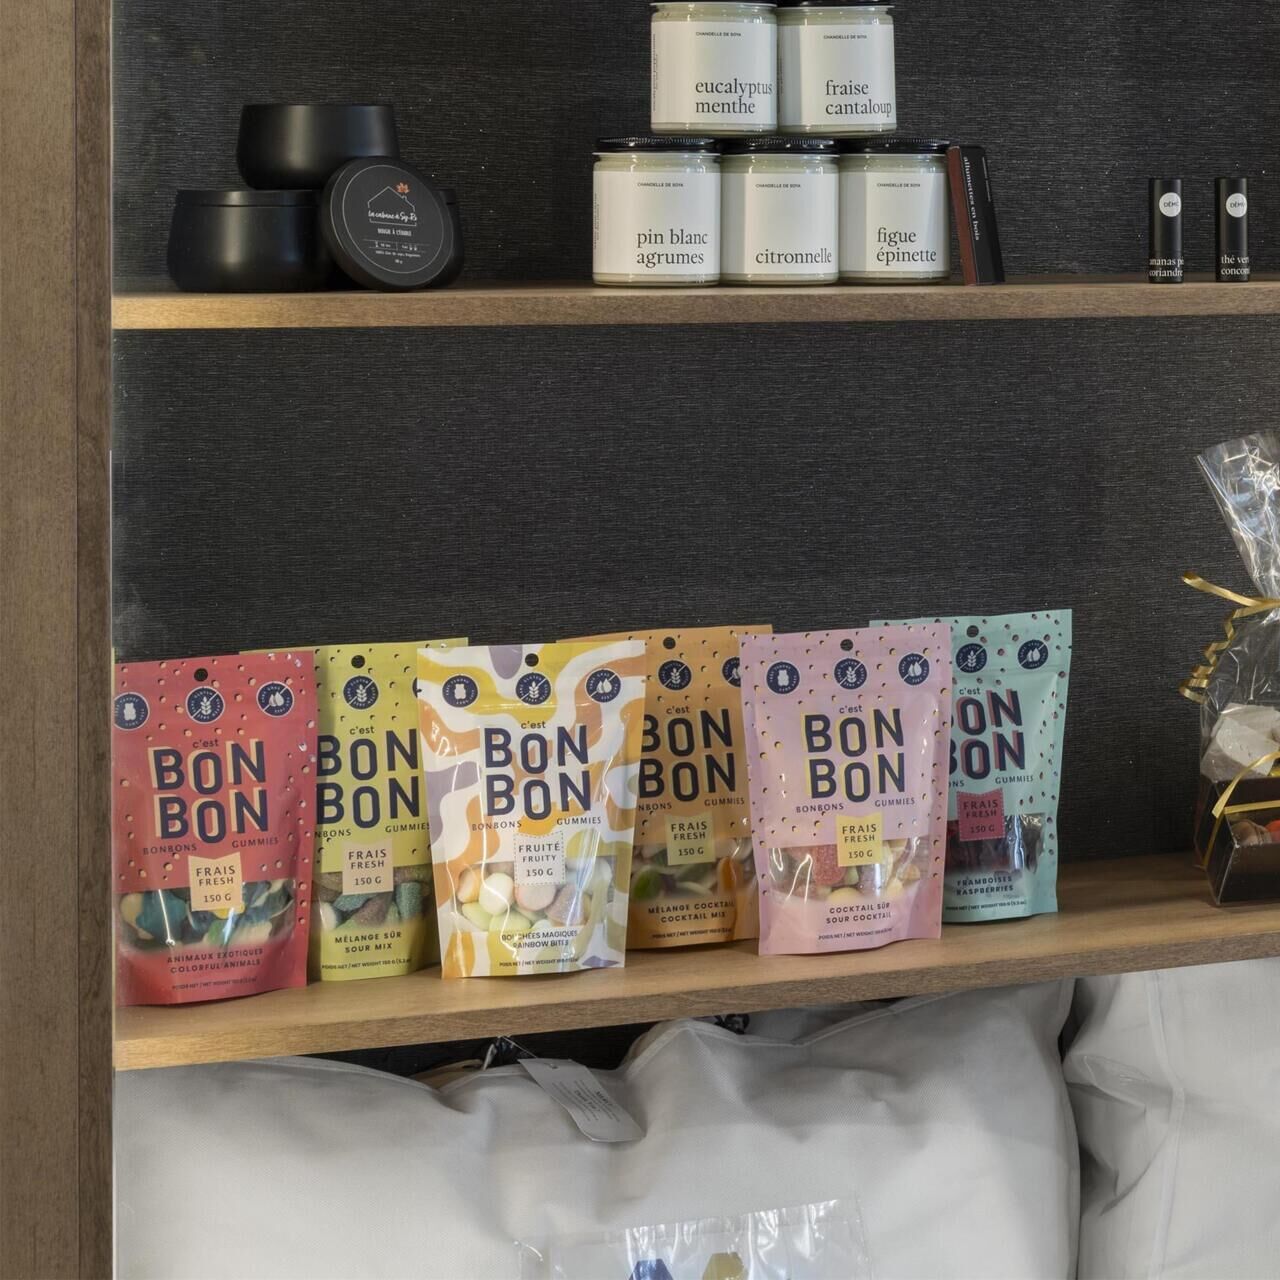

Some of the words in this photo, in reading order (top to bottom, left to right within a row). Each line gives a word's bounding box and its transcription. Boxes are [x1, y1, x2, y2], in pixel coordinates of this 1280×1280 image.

[695, 78, 774, 98] eucalyptus
[825, 79, 869, 96] fraise
[695, 96, 756, 114] menthe
[825, 99, 892, 119] cantaloup
[963, 156, 975, 205] allumettes
[637, 229, 665, 249] pin
[669, 228, 708, 245] blanc
[876, 227, 917, 247] figue
[636, 250, 705, 268] agrumes
[755, 247, 832, 265] citronnelle
[876, 246, 937, 266] épinette
[1221, 254, 1235, 264] thé
[666, 705, 690, 715] c'est
[838, 705, 863, 715] c'est
[349, 725, 375, 735] c'est
[520, 720, 546, 730] c'est
[642, 708, 732, 758] BON
[801, 708, 905, 757] BON
[316, 728, 419, 781] BON
[484, 724, 590, 775] BON
[150, 738, 267, 796] BON
[639, 752, 736, 802] BON
[806, 752, 906, 803] BON
[994, 775, 1034, 785] GUMMIES
[485, 770, 591, 821] BON
[316, 776, 421, 829] BON
[704, 797, 745, 807] GUMMIES
[795, 802, 844, 813] BONBONS
[874, 797, 915, 808] GUMMIES
[963, 799, 999, 810] FRAIS
[153, 786, 269, 844] BON
[966, 809, 997, 819] FRESH
[471, 820, 523, 832] BONBONS
[556, 816, 602, 826] GUMMIES
[670, 821, 708, 832] FRAIS
[842, 823, 877, 834] FRAIS
[673, 831, 706, 841] FRESH
[844, 833, 875, 843] FRESH
[231, 837, 279, 849] GUMMIES
[518, 840, 561, 854] FRUITÉ
[143, 843, 197, 856] BONBONS
[348, 849, 387, 860] FRAIS
[678, 848, 695, 856] 150
[848, 850, 865, 859] 150
[866, 850, 873, 858] G
[522, 854, 557, 864] FRUITY
[350, 860, 385, 870] FRESH
[196, 867, 236, 878] FRAIS
[526, 868, 544, 877] 150
[545, 868, 554, 877] G
[198, 875, 234, 886] FRESH
[354, 876, 372, 886] 150
[373, 876, 382, 885] G
[957, 876, 1012, 886] FRAMBOISES
[956, 885, 1014, 896] RASPBERRIES
[203, 893, 221, 903] 150
[648, 904, 690, 914] MÉLANGE
[829, 905, 874, 914] COCKTAIL
[877, 901, 890, 910] SÛR
[661, 914, 707, 923] COCKTAIL
[826, 916, 850, 924] SOUR
[852, 912, 892, 922] COCKTAIL
[335, 933, 380, 944] MÉLANGE
[383, 931, 402, 940] SÛR
[345, 945, 371, 954] SOUR
[374, 942, 393, 951] MIX
[167, 953, 214, 964] ANIMAUX
[217, 948, 263, 959] EXOTIQUES
[170, 963, 221, 973] COLORFUL
[223, 959, 261, 969] ANIMALS
